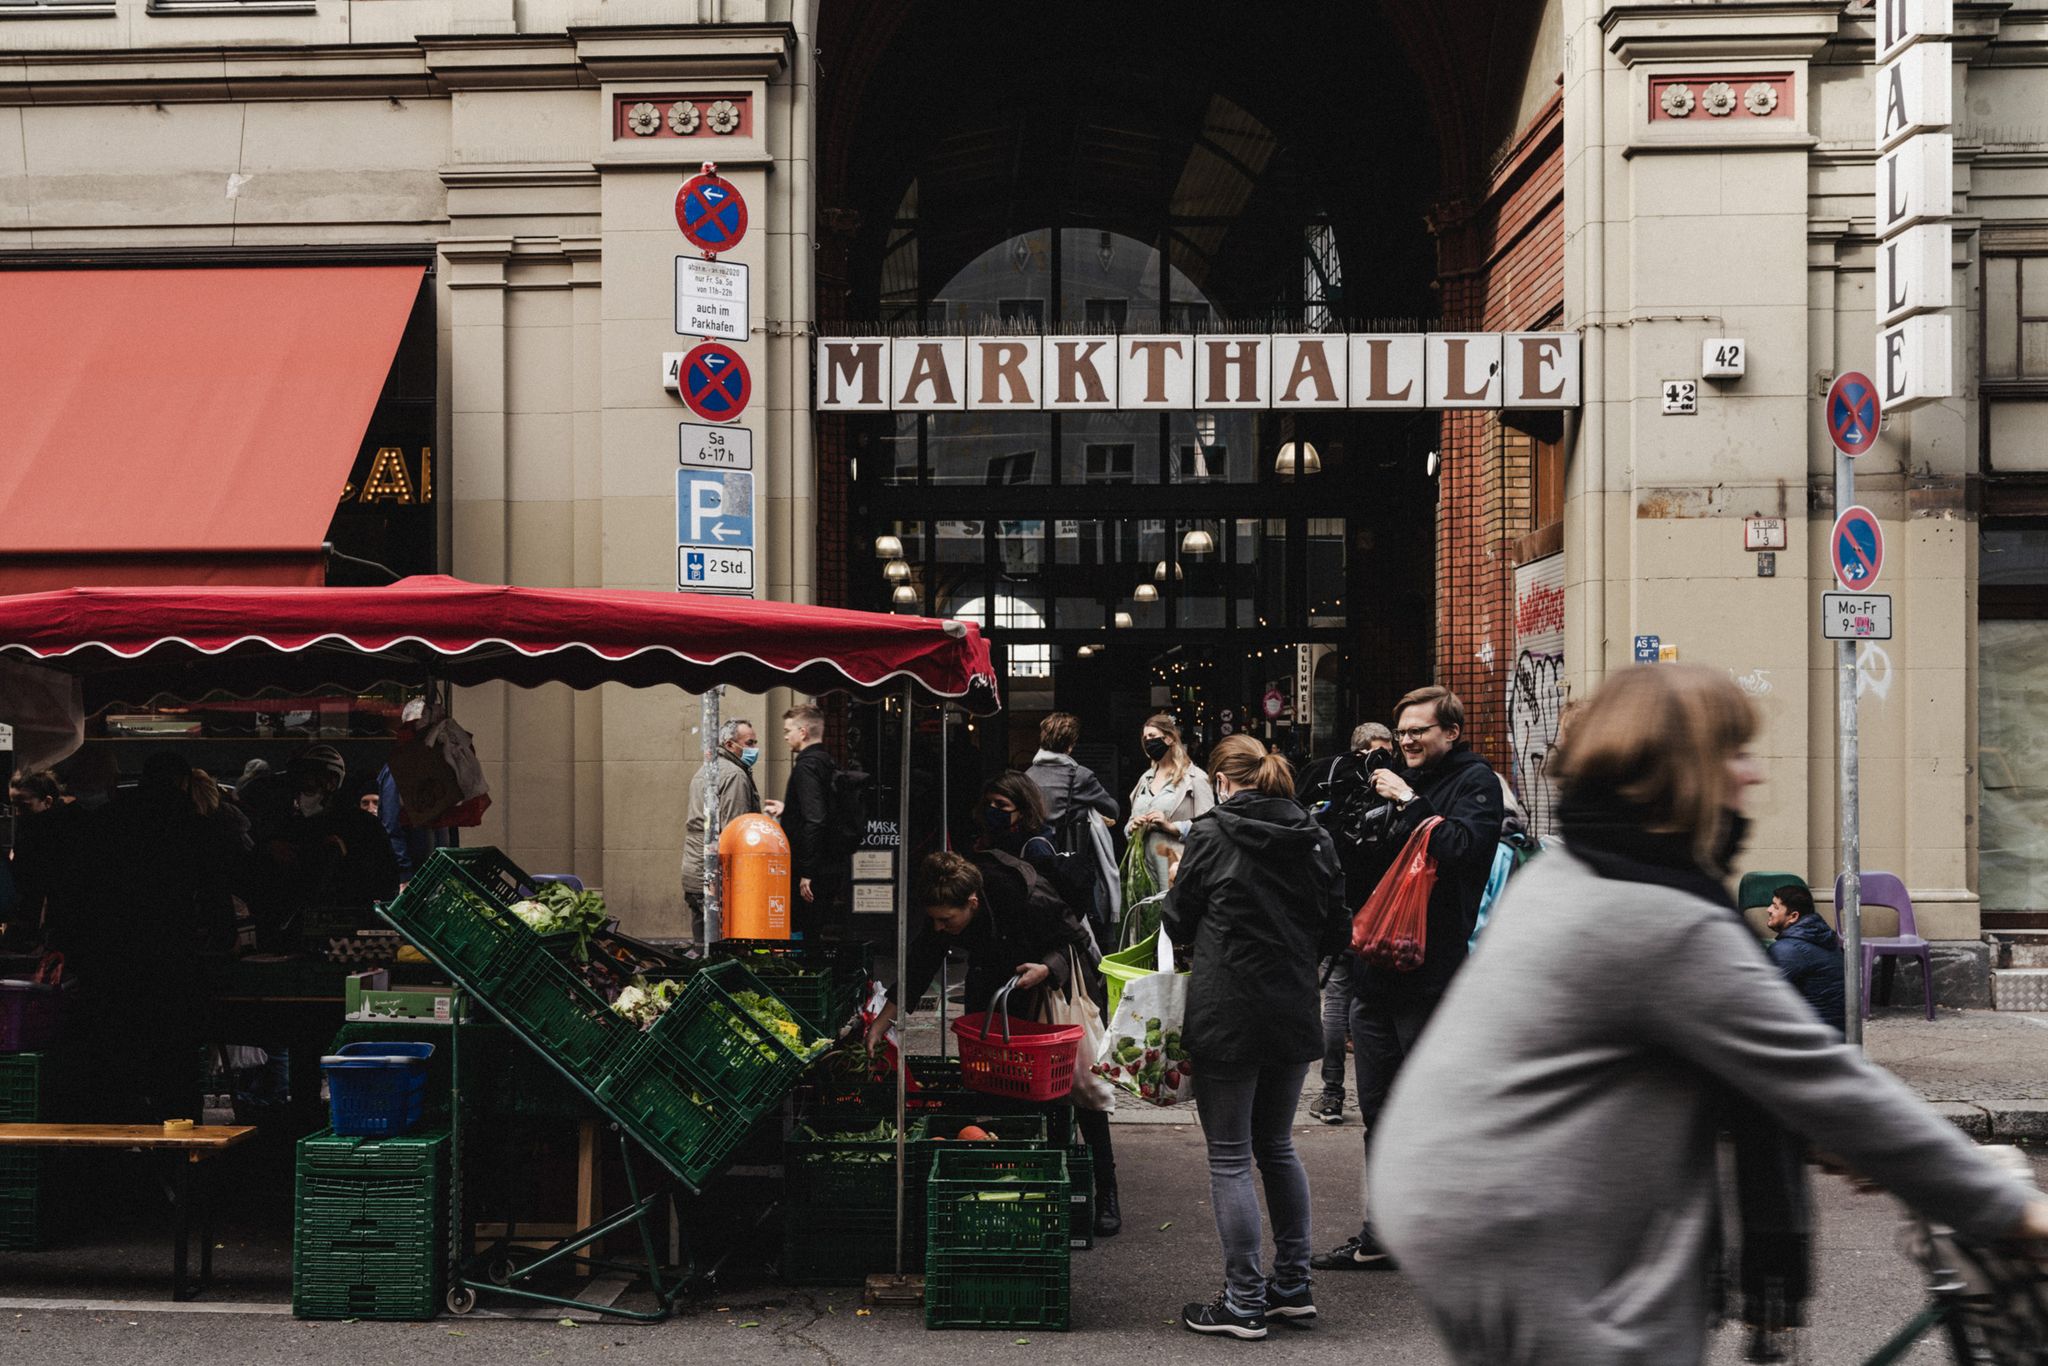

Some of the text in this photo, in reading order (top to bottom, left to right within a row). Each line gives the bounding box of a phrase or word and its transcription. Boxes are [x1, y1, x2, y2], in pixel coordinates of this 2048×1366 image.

[696, 304, 730, 317] auch im
[691, 317, 734, 333] Parkhafen
[1714, 345, 1740, 368] 42
[823, 336, 1568, 405] MARKTHALLE
[1665, 383, 1696, 403] 42
[708, 431, 725, 446] Sa
[689, 479, 725, 541] P
[1762, 536, 1769, 546] 3
[709, 559, 747, 575] 2 Std.
[1838, 601, 1877, 615] Mo-Fr
[867, 820, 898, 834] MASK
[867, 833, 901, 846] COFFEE
